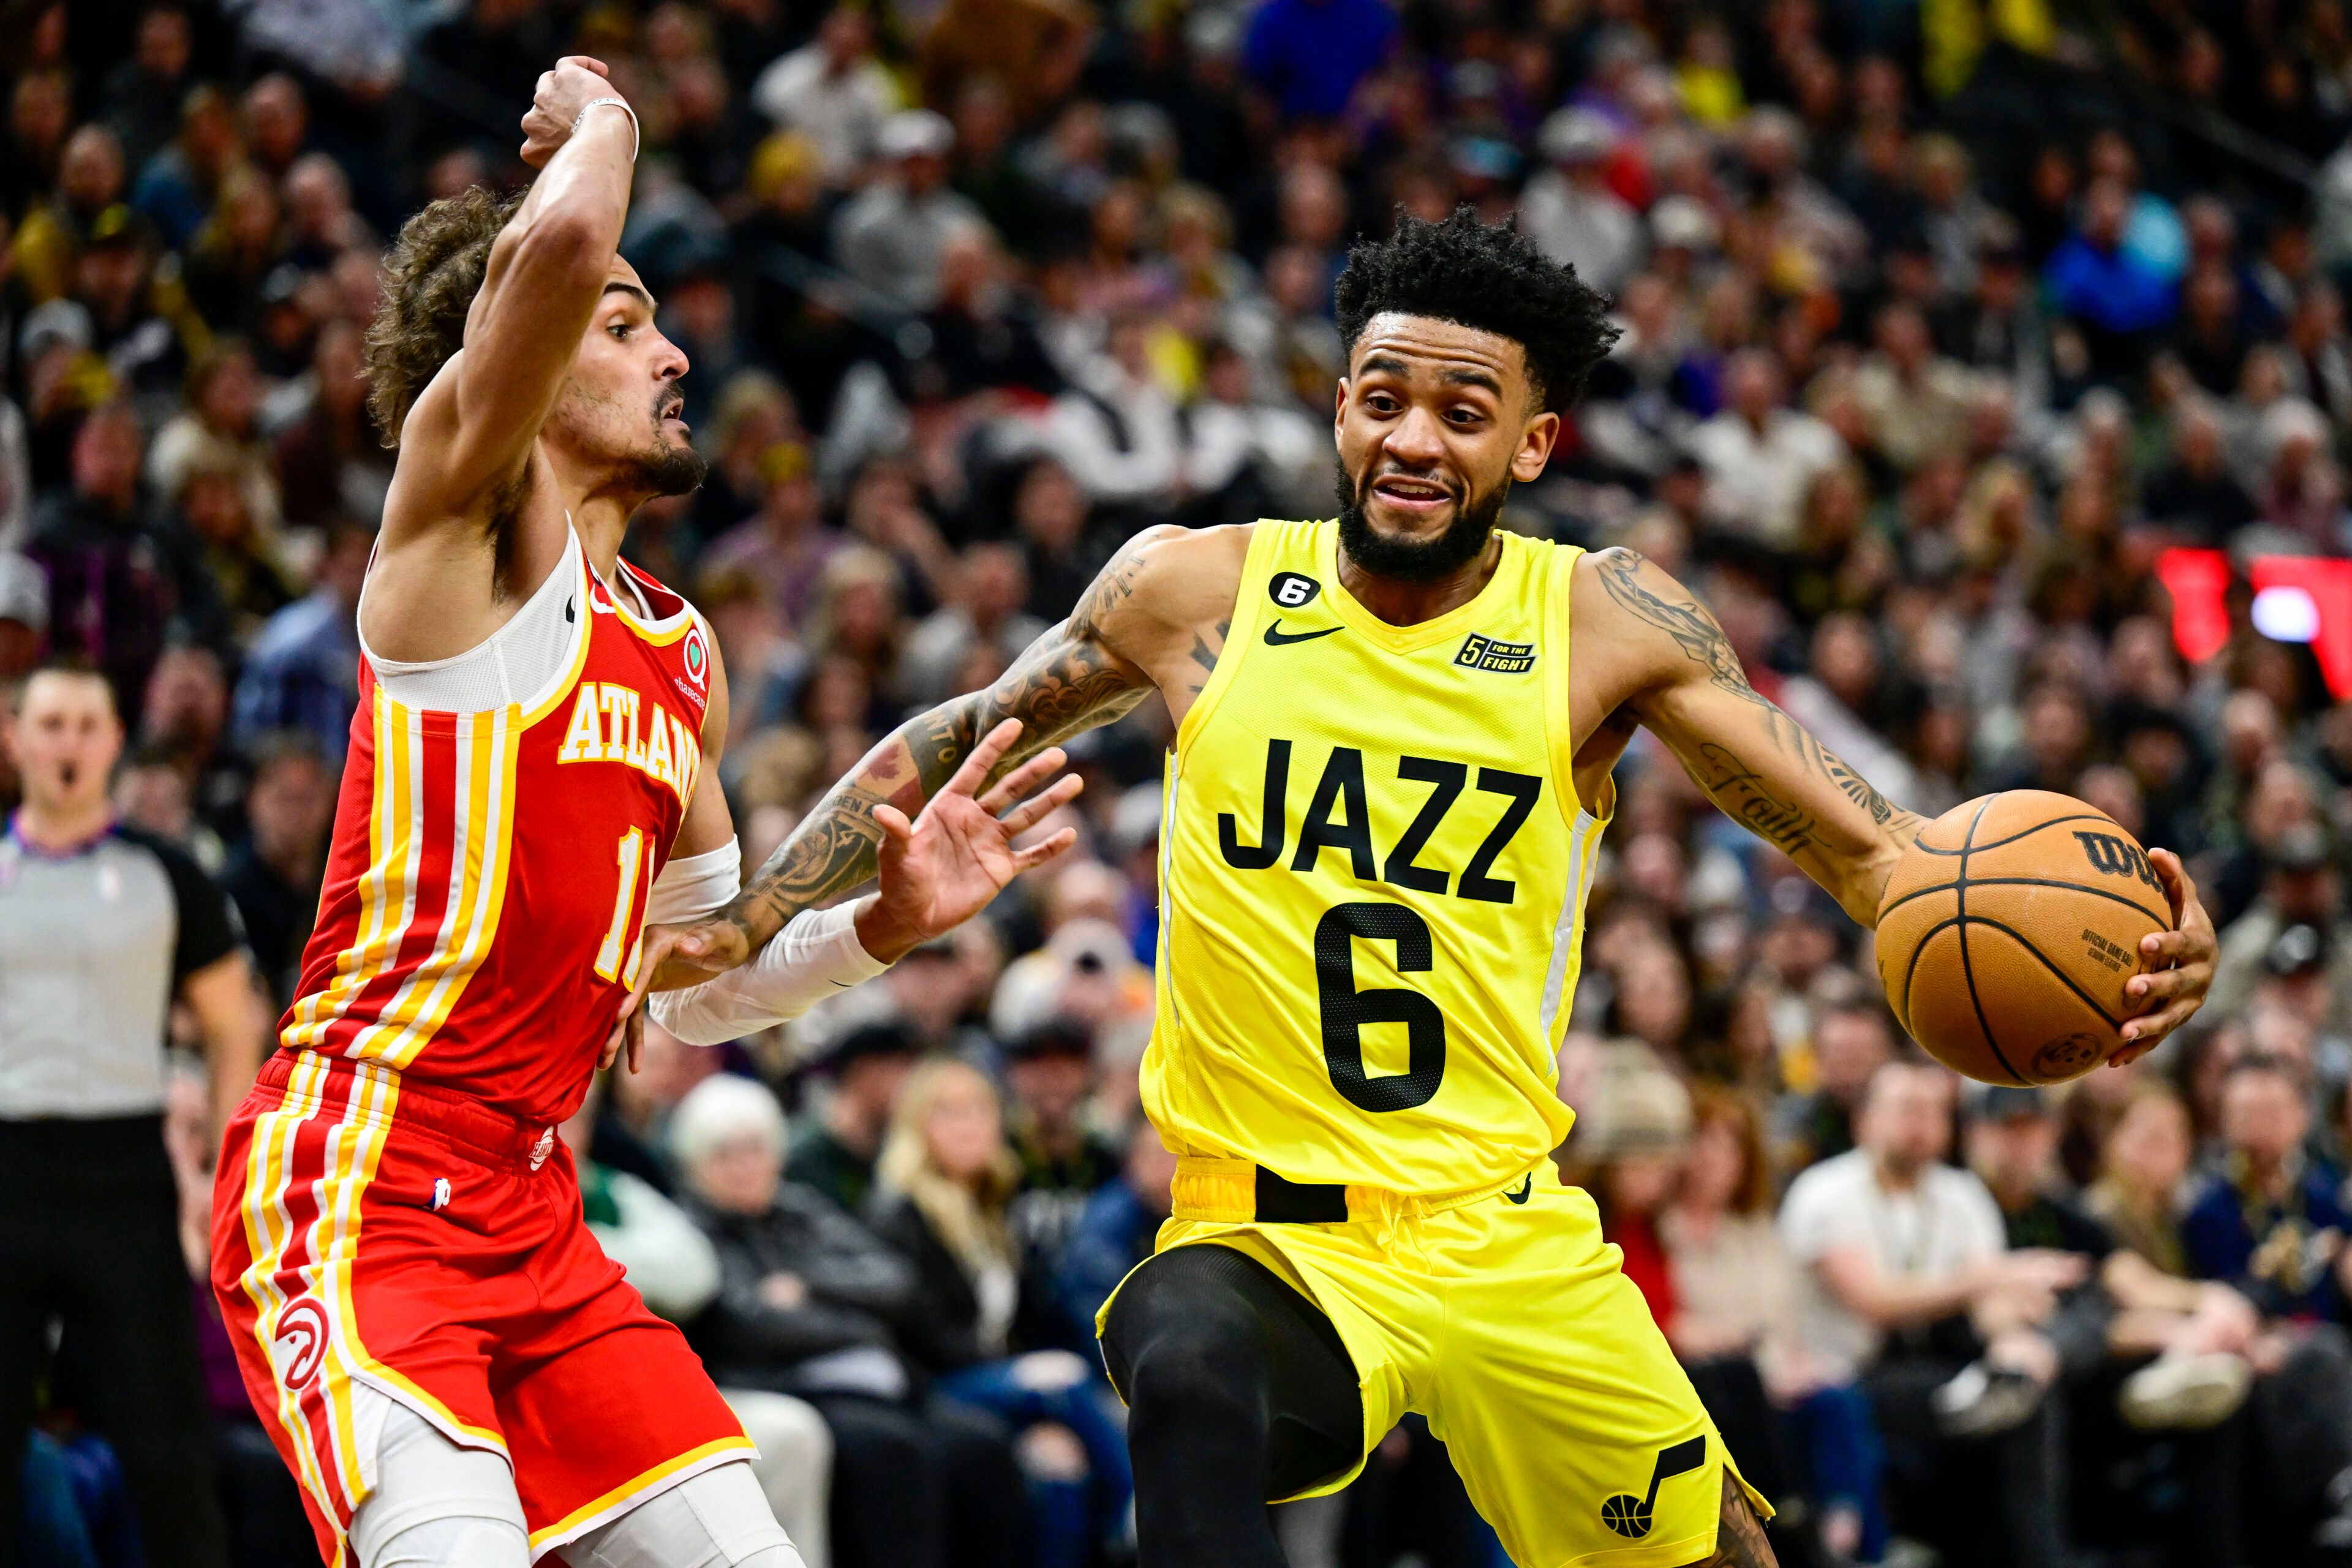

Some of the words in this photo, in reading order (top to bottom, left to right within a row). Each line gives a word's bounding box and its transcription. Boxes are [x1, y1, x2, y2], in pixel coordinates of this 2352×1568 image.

[1278, 578, 1311, 604] 6
[1461, 638, 1485, 664] 5
[1492, 644, 1509, 654] FOR
[1483, 657, 1530, 670] FIGHT
[1698, 742, 1833, 856] Faith
[1218, 739, 1542, 904] JAZZ
[2082, 929, 2108, 951] OFFICIAL
[1314, 902, 1446, 1113] 6
